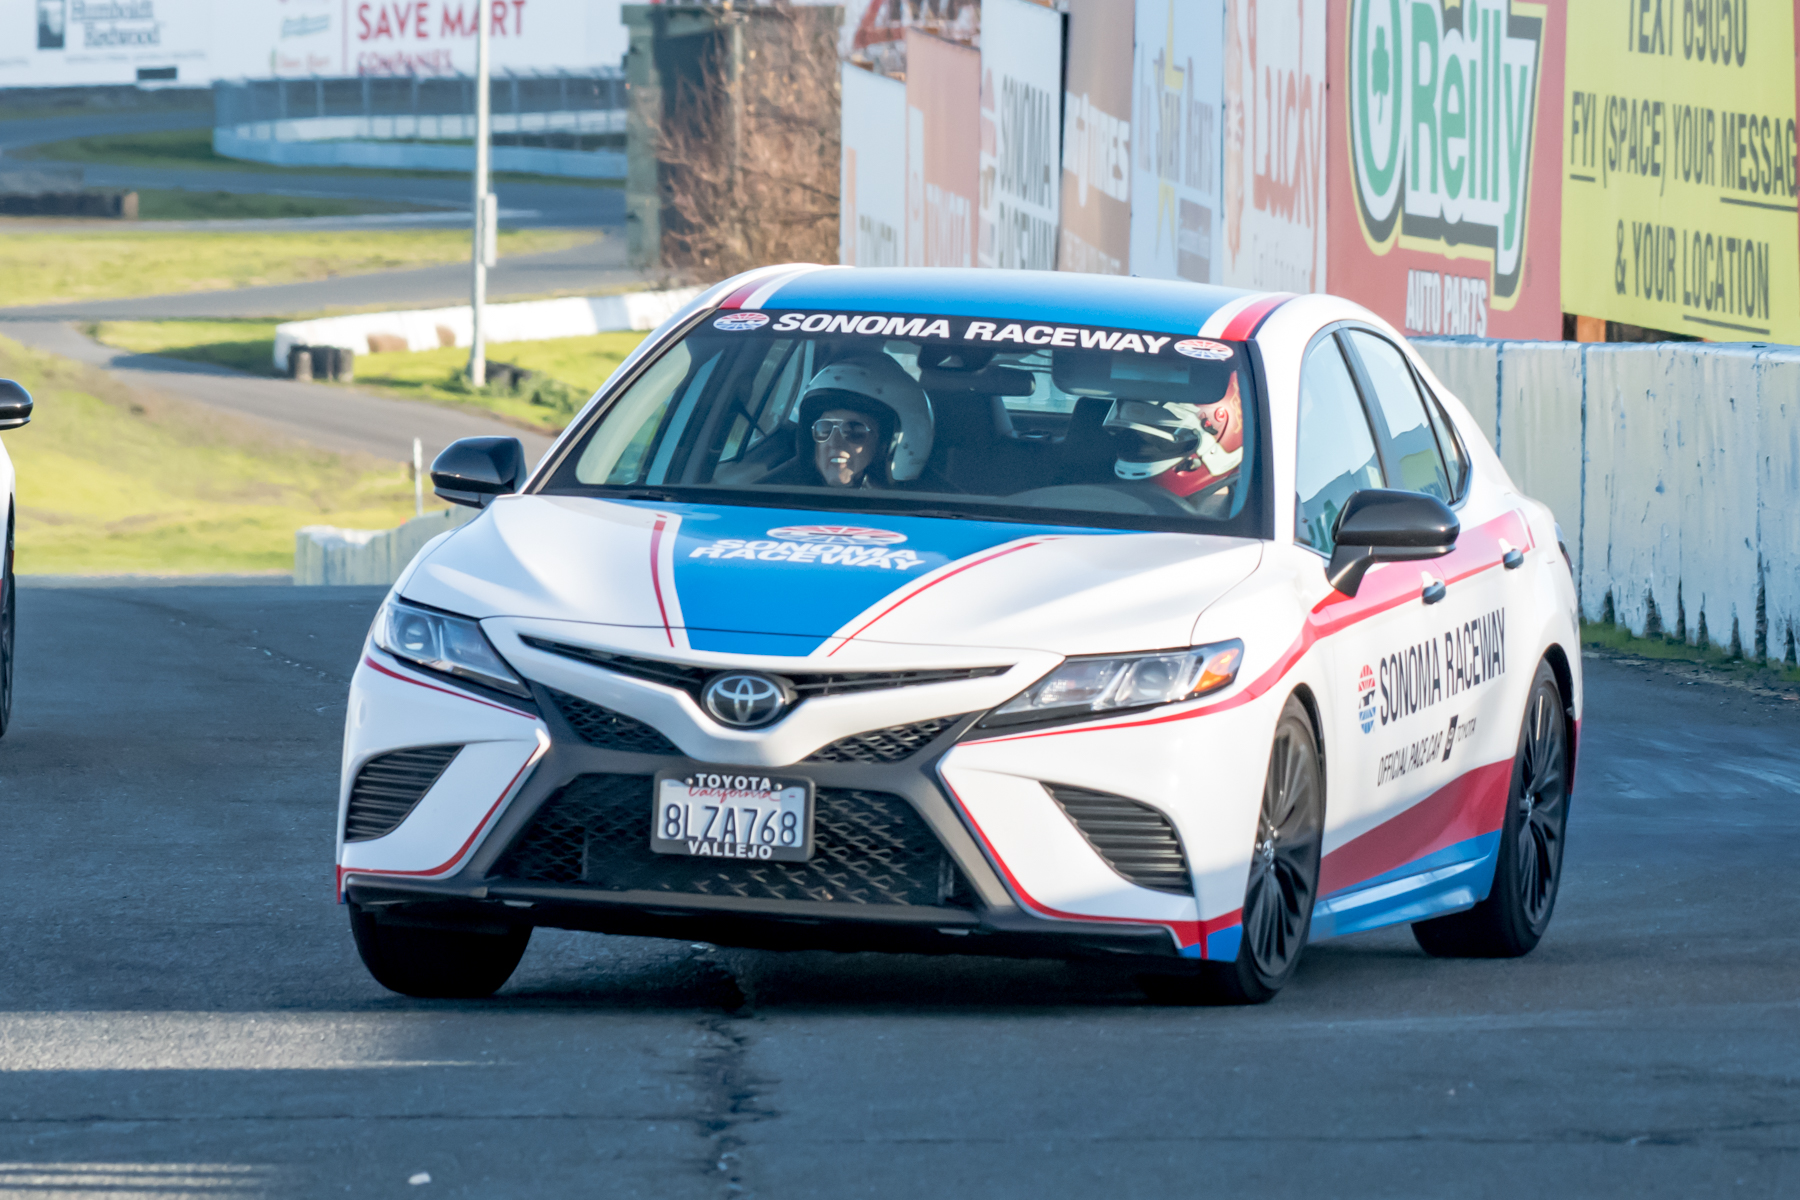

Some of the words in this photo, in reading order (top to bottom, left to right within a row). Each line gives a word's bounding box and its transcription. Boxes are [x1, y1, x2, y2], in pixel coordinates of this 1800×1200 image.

[357, 2, 430, 41] SAVE
[440, 0, 526, 38] MART
[1628, 0, 1673, 56] TEXT
[1247, 0, 1323, 293] Lucky
[1357, 0, 1528, 252] OReilly
[1570, 90, 1596, 168] FYI
[1602, 94, 1666, 197] (SPACE)
[1672, 103, 1716, 187] YOUR
[1720, 111, 1797, 199] MESSAG
[1614, 218, 1626, 295] &
[1632, 221, 1676, 303] YOUR
[1683, 229, 1769, 320] LOCATION
[1405, 268, 1442, 335] AUTO
[1443, 273, 1487, 338] PARTS
[772, 313, 950, 339] SONOMA
[963, 320, 1171, 356] RACEWAY
[688, 546, 926, 571] RACEWAY
[711, 538, 918, 560] SONOMA
[1380, 637, 1442, 727] SONOMA
[1444, 606, 1506, 699] RACEWAY
[1455, 716, 1477, 744] TOYOTA
[695, 773, 771, 791] TOYOTA
[1377, 743, 1409, 788] OFFICIAL
[1406, 734, 1429, 773] PACE
[1425, 729, 1444, 765] CAR
[664, 803, 798, 846] 8LZA768
[688, 840, 773, 860] VALLEJO
